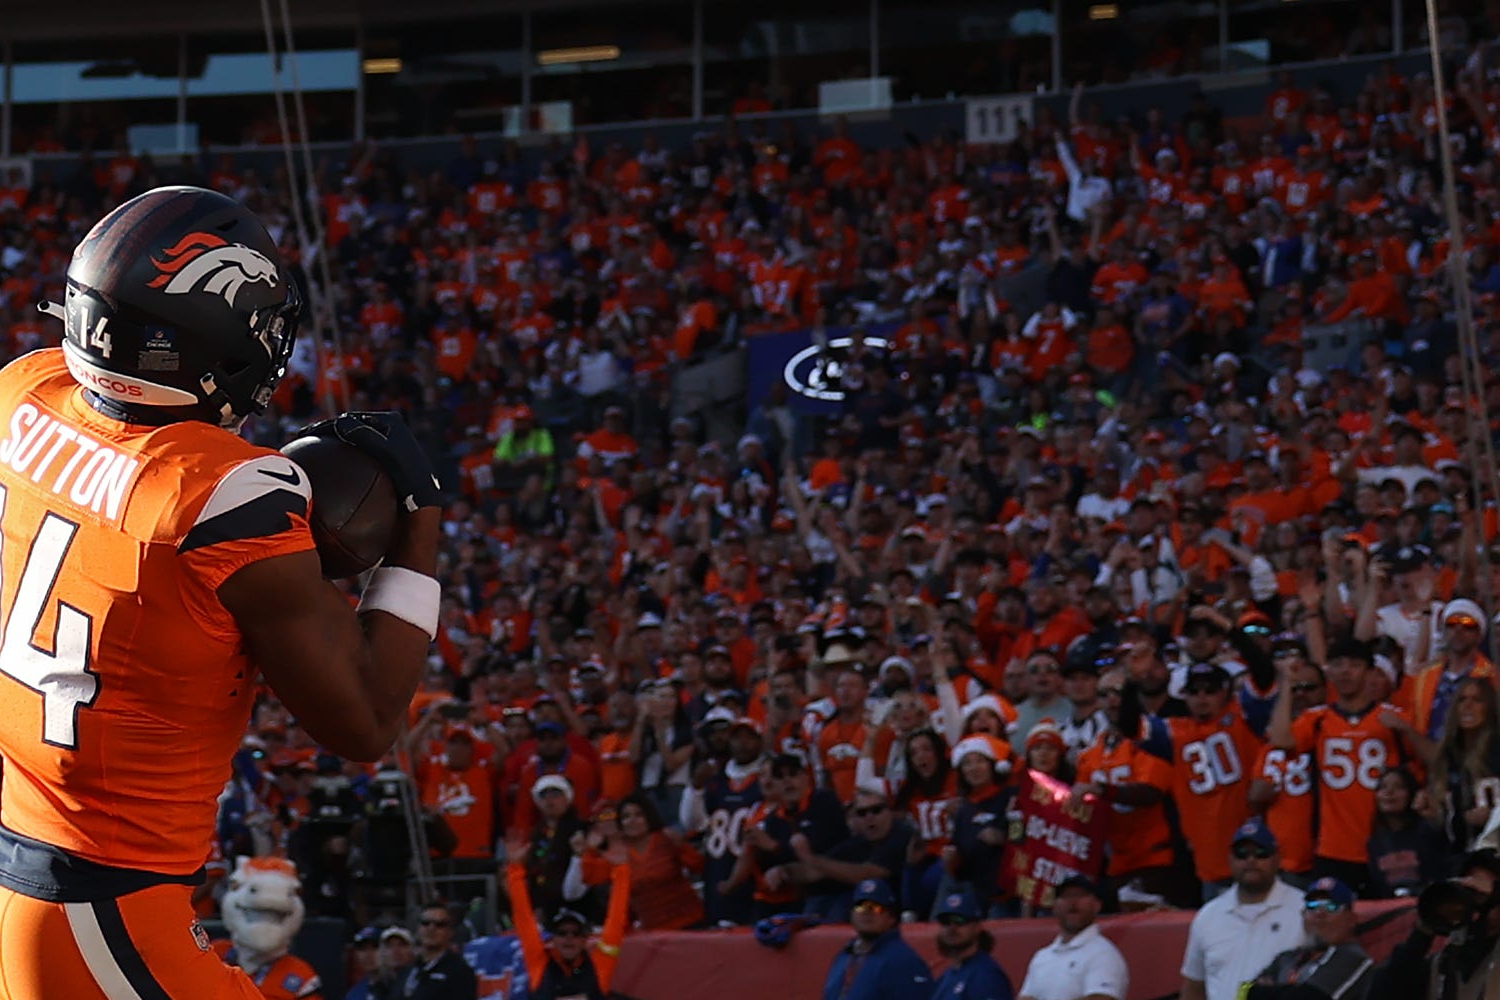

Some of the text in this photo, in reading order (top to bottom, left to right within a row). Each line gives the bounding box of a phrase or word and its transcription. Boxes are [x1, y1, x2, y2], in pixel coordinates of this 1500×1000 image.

[81, 306, 113, 359] 14
[0, 403, 138, 520] SUTTON
[1183, 731, 1243, 795] 30
[1322, 737, 1388, 791] 58
